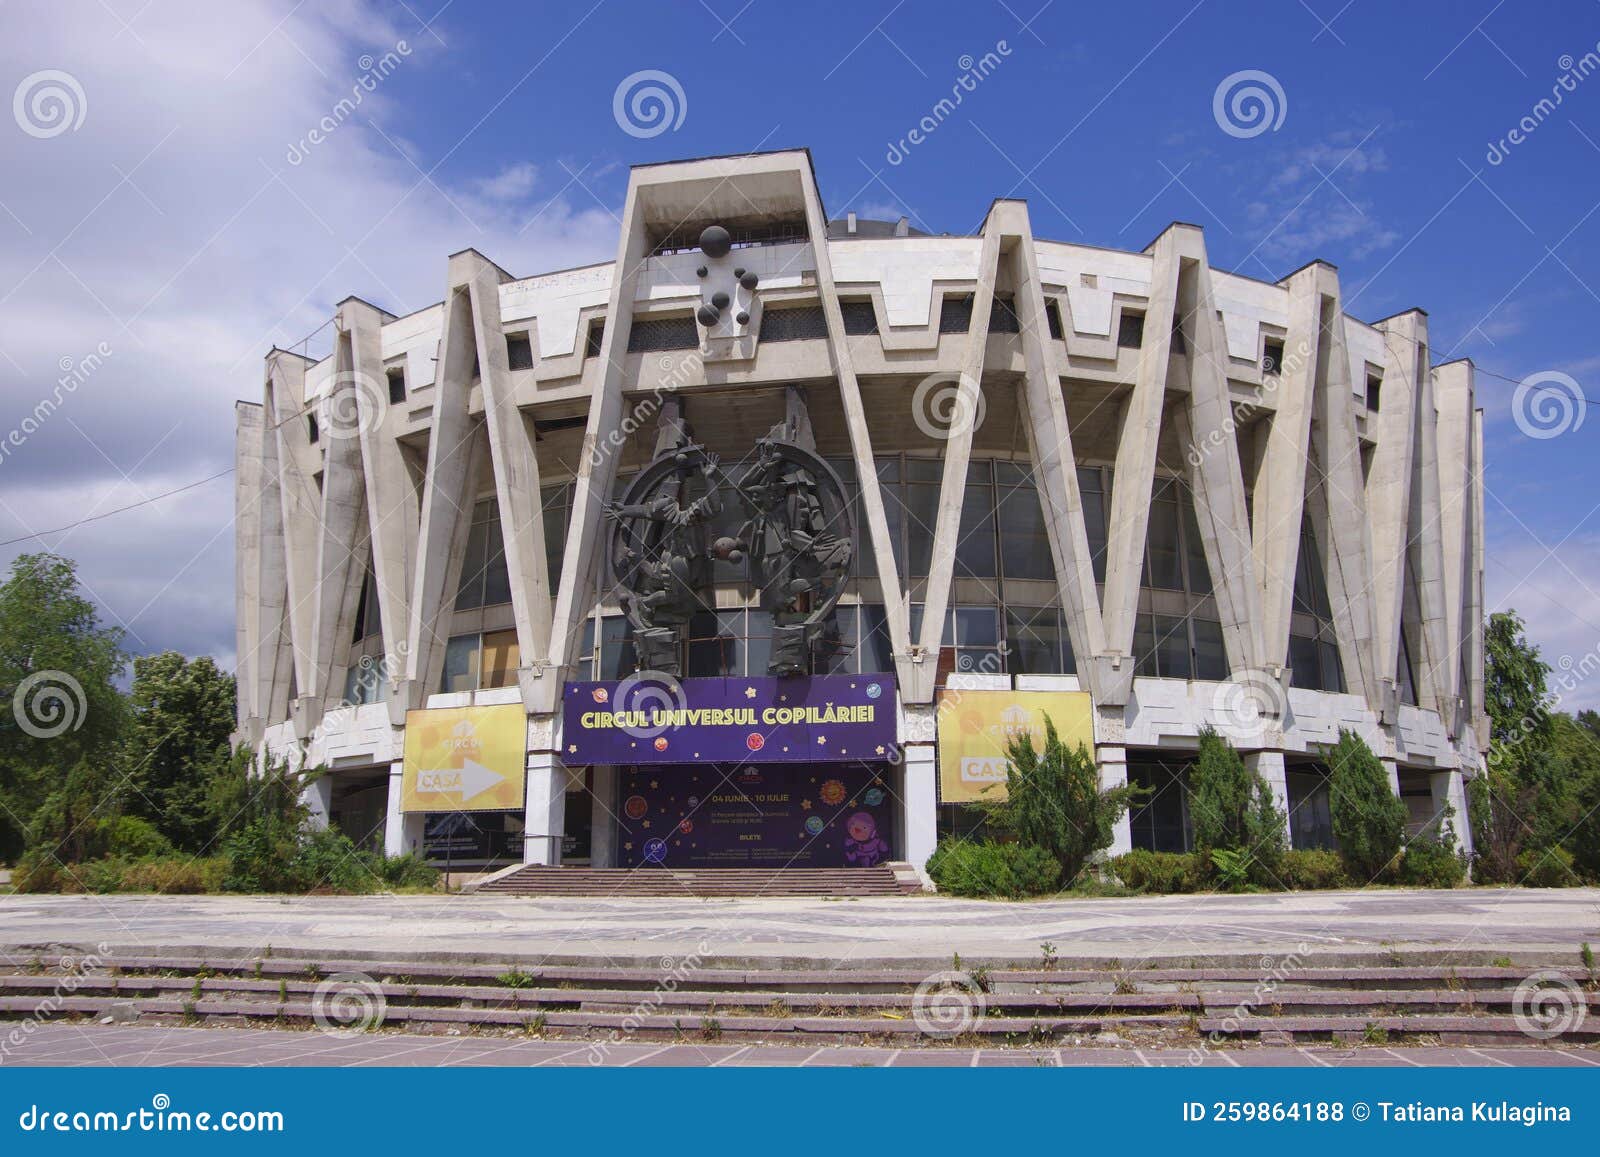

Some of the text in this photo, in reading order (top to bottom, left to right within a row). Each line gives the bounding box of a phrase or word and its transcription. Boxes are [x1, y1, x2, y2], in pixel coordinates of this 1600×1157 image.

[581, 702, 875, 728] CIRCUL UNIVERSUL COPILĂRIEI
[990, 724, 1042, 736] CIRCUL
[966, 762, 1008, 777] CAS
[421, 773, 463, 789] CASA
[755, 794, 765, 802] 10
[767, 794, 789, 802] IULIE
